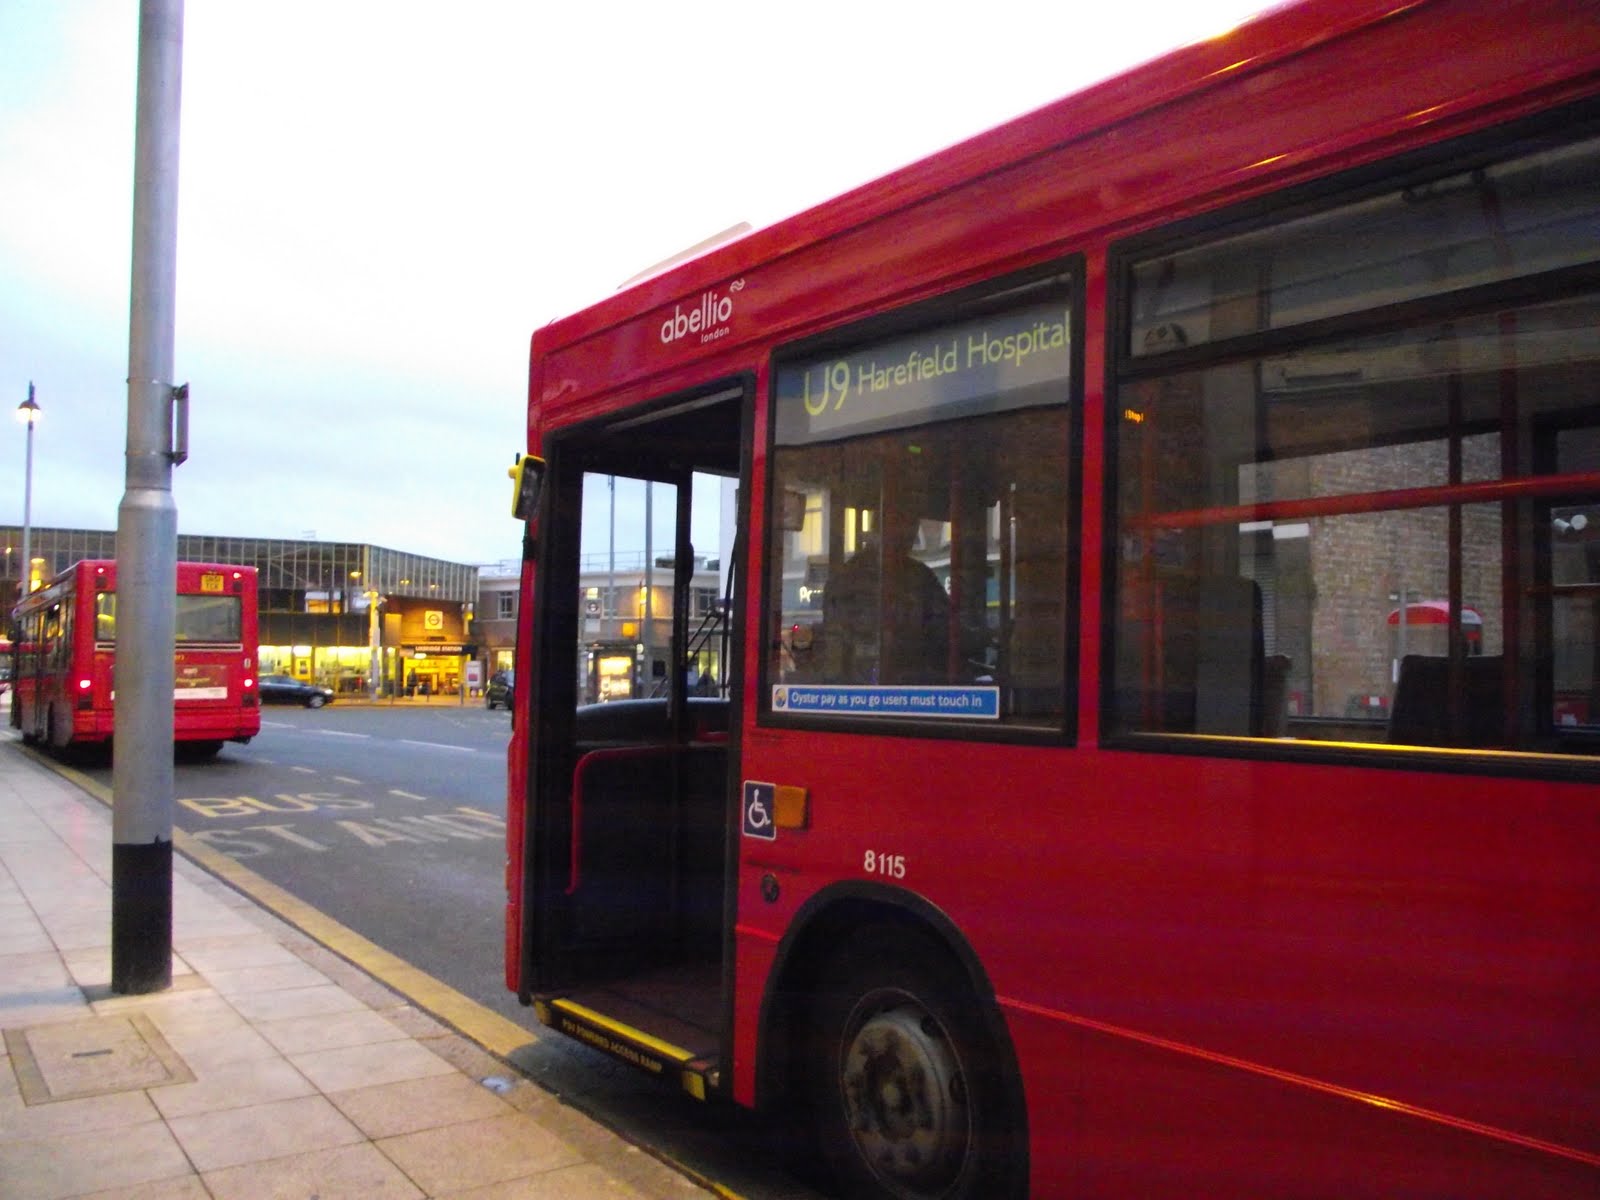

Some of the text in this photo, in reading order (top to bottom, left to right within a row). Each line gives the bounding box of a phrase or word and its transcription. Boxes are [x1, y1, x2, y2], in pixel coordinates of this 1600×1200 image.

[661, 291, 732, 343] abellio
[701, 326, 730, 343] london
[804, 310, 1071, 417] U9 Harefield Hospital
[791, 691, 983, 708] Oyster pay as you go users must touch in
[177, 793, 375, 817] BUS
[864, 849, 906, 879] 8115
